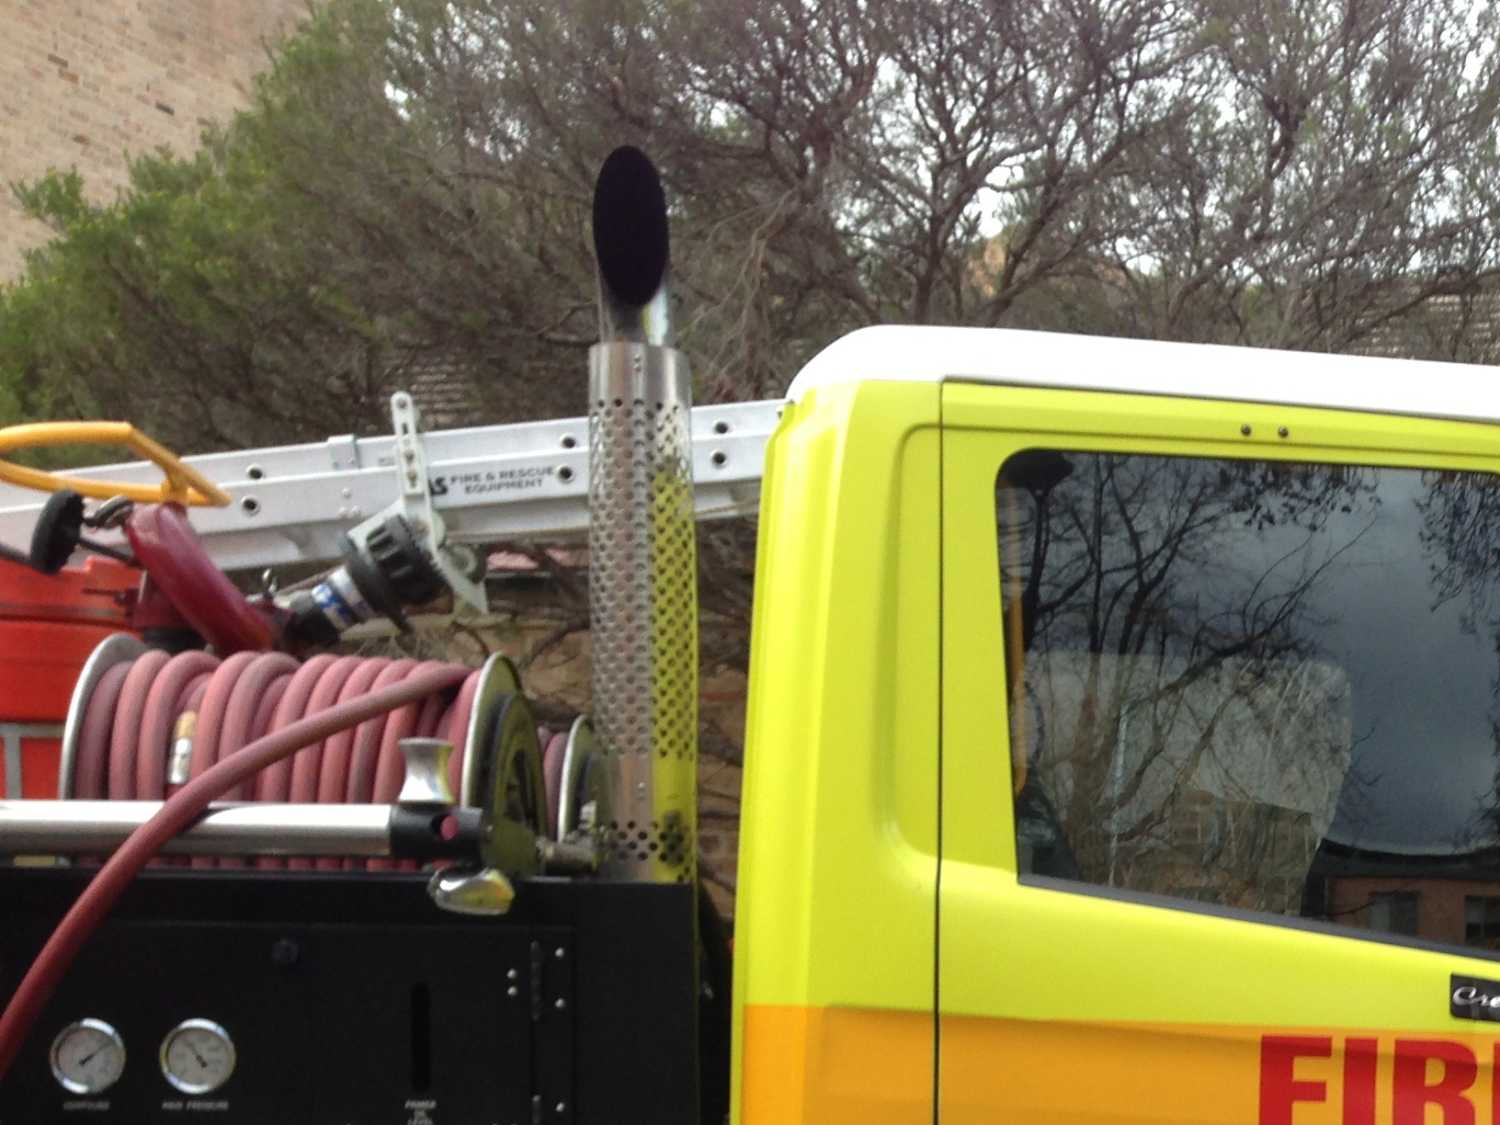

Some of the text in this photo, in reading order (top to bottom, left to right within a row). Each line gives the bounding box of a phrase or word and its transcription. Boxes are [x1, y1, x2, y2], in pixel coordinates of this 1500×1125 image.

[450, 472, 481, 484] FIRE
[486, 471, 495, 482] &
[498, 466, 554, 481] RESCUE
[464, 478, 543, 494] EQUIPMENT
